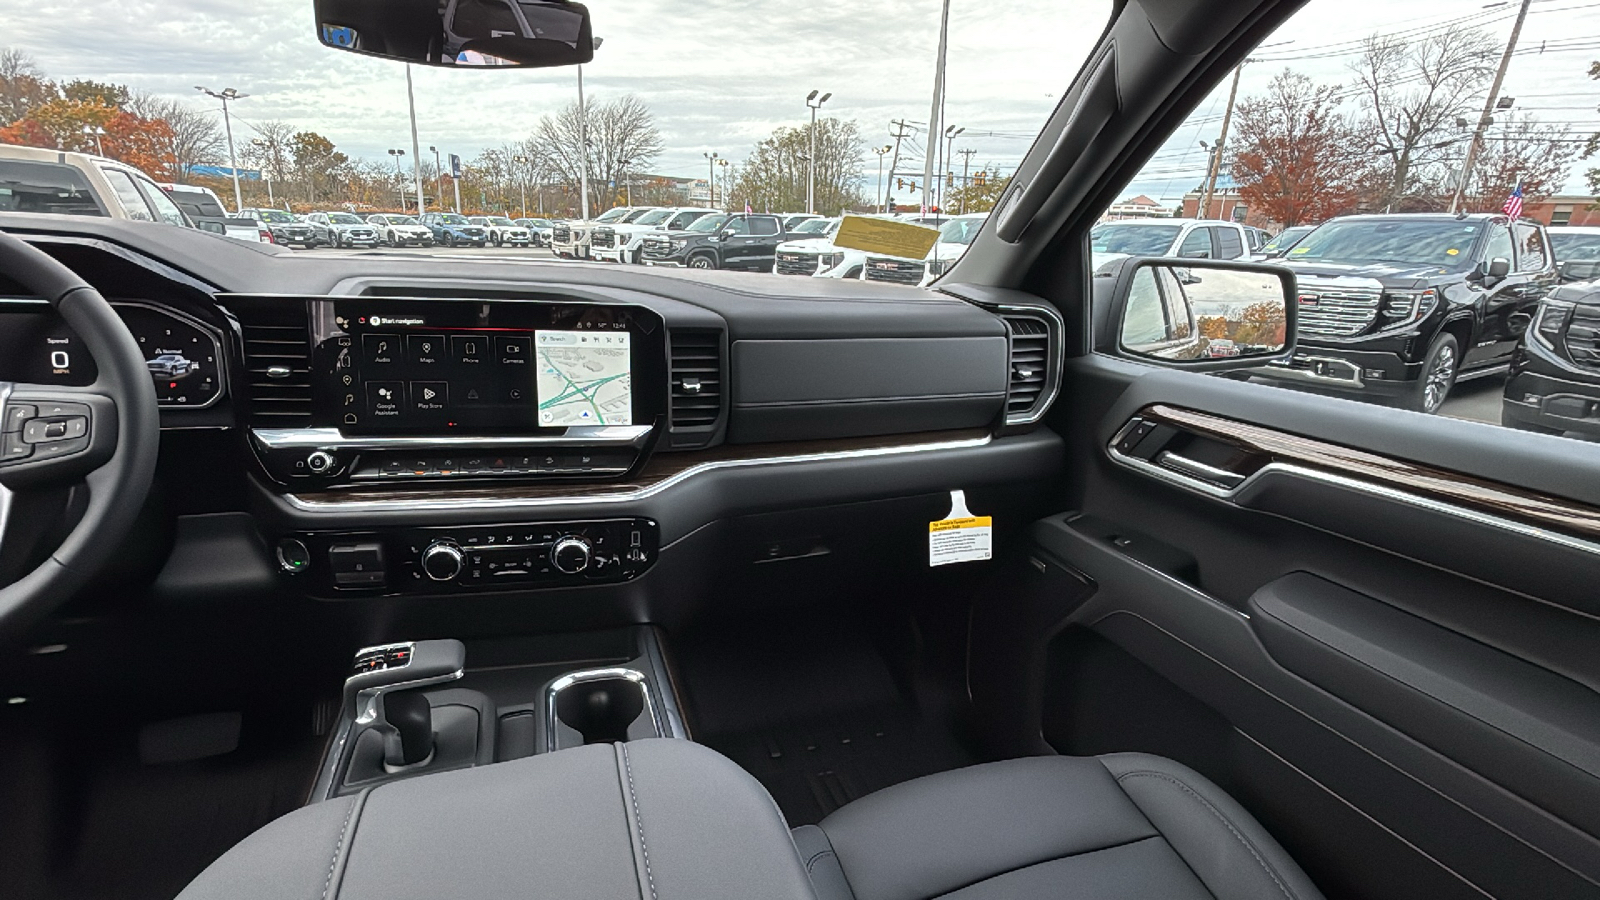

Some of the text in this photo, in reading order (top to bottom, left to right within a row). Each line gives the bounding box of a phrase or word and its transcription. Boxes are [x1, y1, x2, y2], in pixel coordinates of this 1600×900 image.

[395, 318, 424, 326] navigation
[46, 337, 69, 345] Speed
[376, 402, 396, 410] Google
[417, 402, 429, 410] Play
